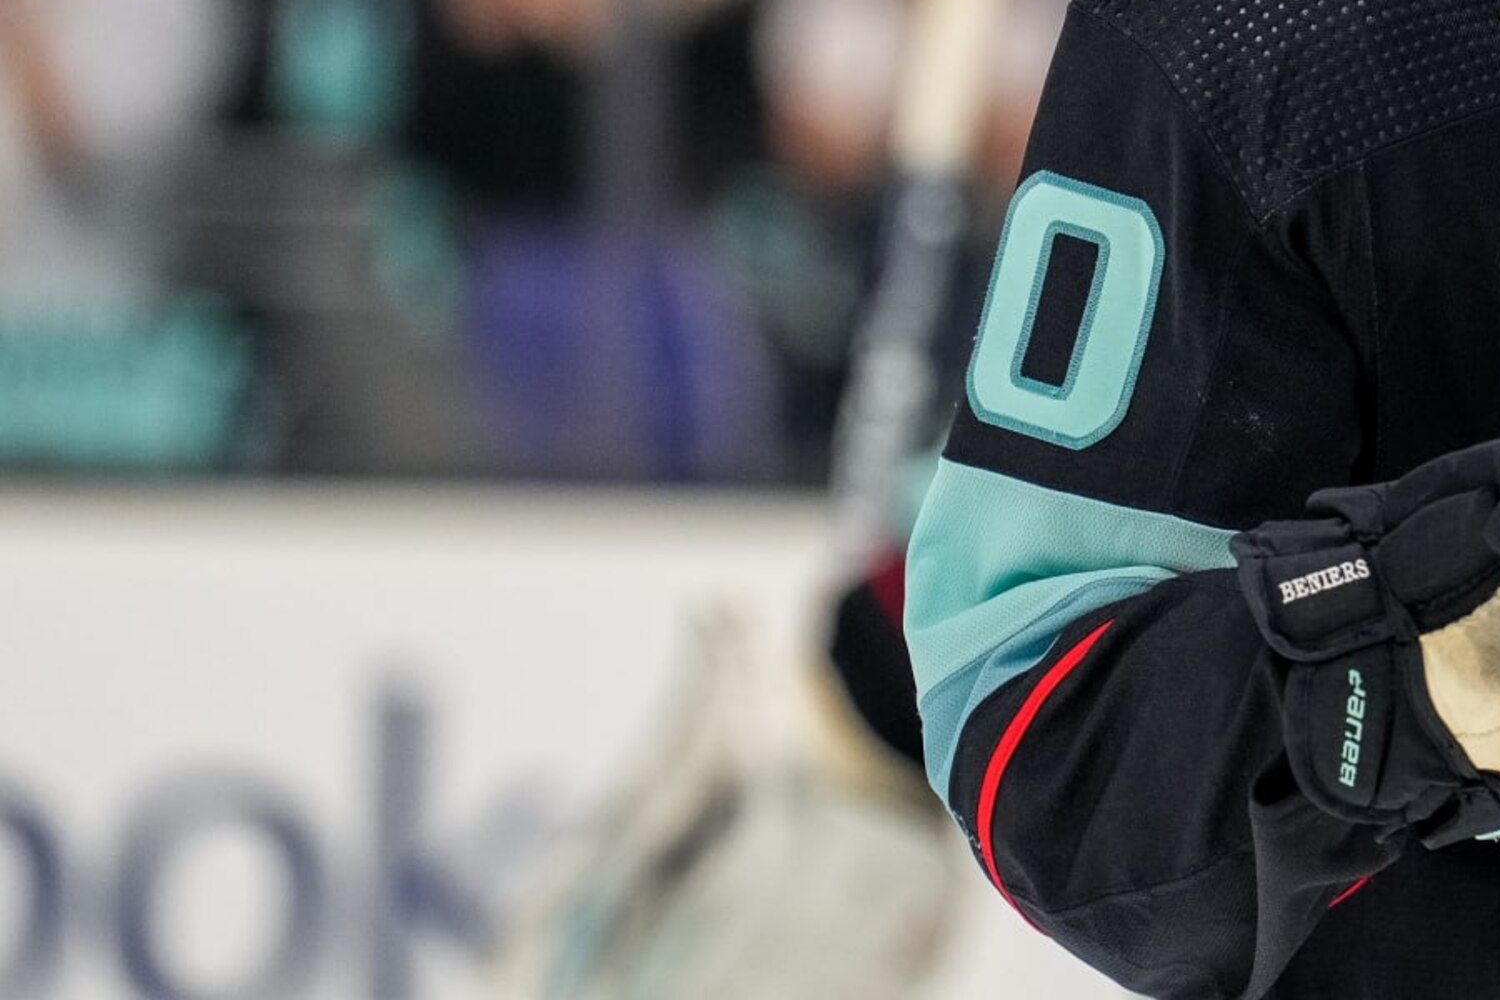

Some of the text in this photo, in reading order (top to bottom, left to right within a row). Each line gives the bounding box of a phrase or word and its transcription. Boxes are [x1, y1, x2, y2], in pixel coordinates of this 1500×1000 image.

[966, 168, 1166, 450] 0
[1278, 558, 1370, 604] BENIERS
[1338, 668, 1367, 788] BAUER
